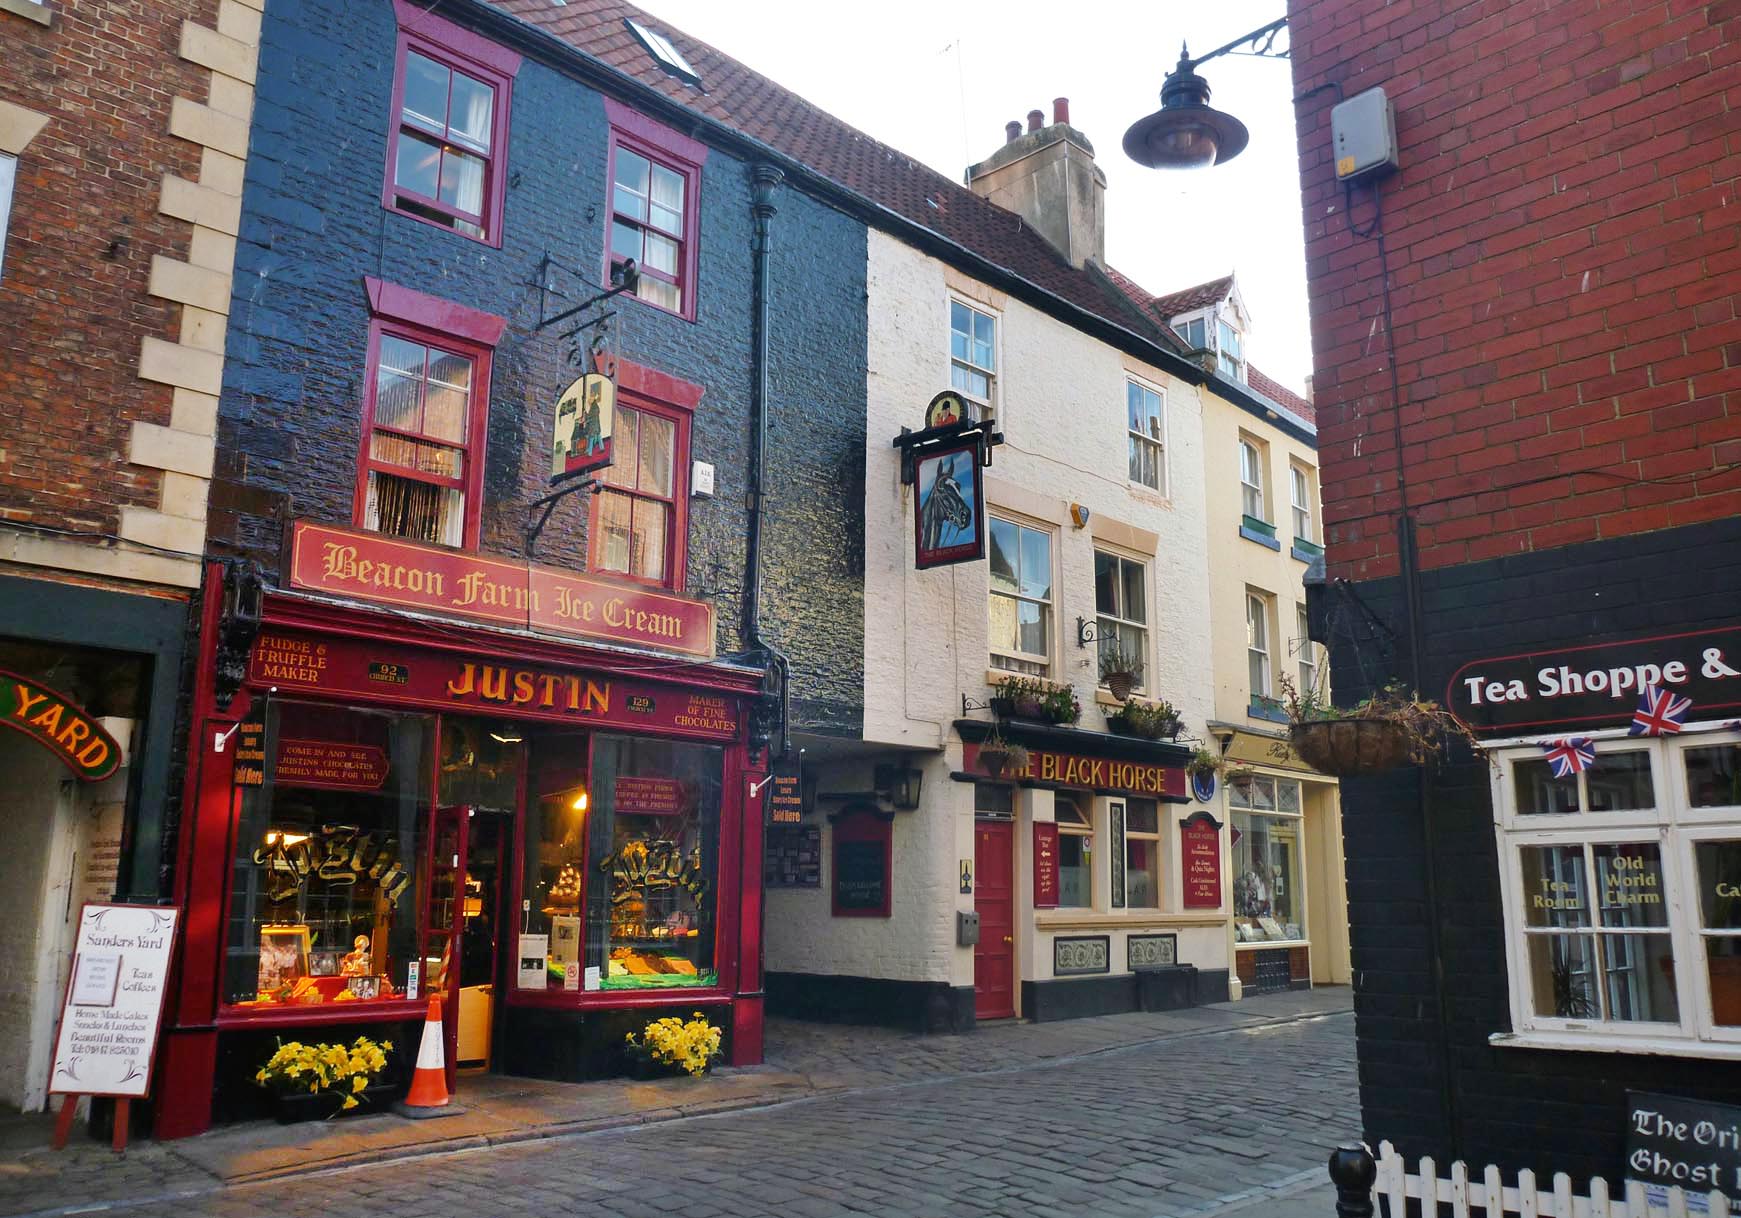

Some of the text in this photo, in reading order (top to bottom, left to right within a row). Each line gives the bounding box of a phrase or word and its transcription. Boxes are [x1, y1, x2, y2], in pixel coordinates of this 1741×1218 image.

[322, 542, 682, 638] Beacon Farm Ice Cream
[260, 636, 326, 656] FUDGE &
[257, 649, 327, 669] TRUFFLE
[263, 664, 319, 682] MAKER
[381, 665, 397, 676] 92
[1464, 647, 1741, 705] Tea Shoppe &
[448, 663, 611, 714] JUSTIN
[689, 696, 725, 708] MAKER
[688, 706, 726, 719] OF FINE
[15, 684, 109, 768] YARD
[674, 715, 737, 731] CHOCOLATES
[328, 750, 347, 758] AND
[1042, 754, 1104, 786] BLACK
[1108, 763, 1167, 793] HORSE
[1612, 856, 1644, 871] Old
[1540, 878, 1569, 892] Tea
[1605, 873, 1657, 888] World
[1606, 890, 1660, 904] Charm
[1715, 882, 1741, 898] Ca
[1533, 895, 1580, 909] Room
[86, 933, 164, 949] Sanders Yard
[132, 968, 153, 979] Teas
[122, 980, 157, 992] Coffees
[75, 1008, 99, 1018] Home
[70, 1031, 146, 1044] Beautiful Rooms
[1632, 1109, 1739, 1150] The Ori
[1630, 1148, 1722, 1186] Ghost
